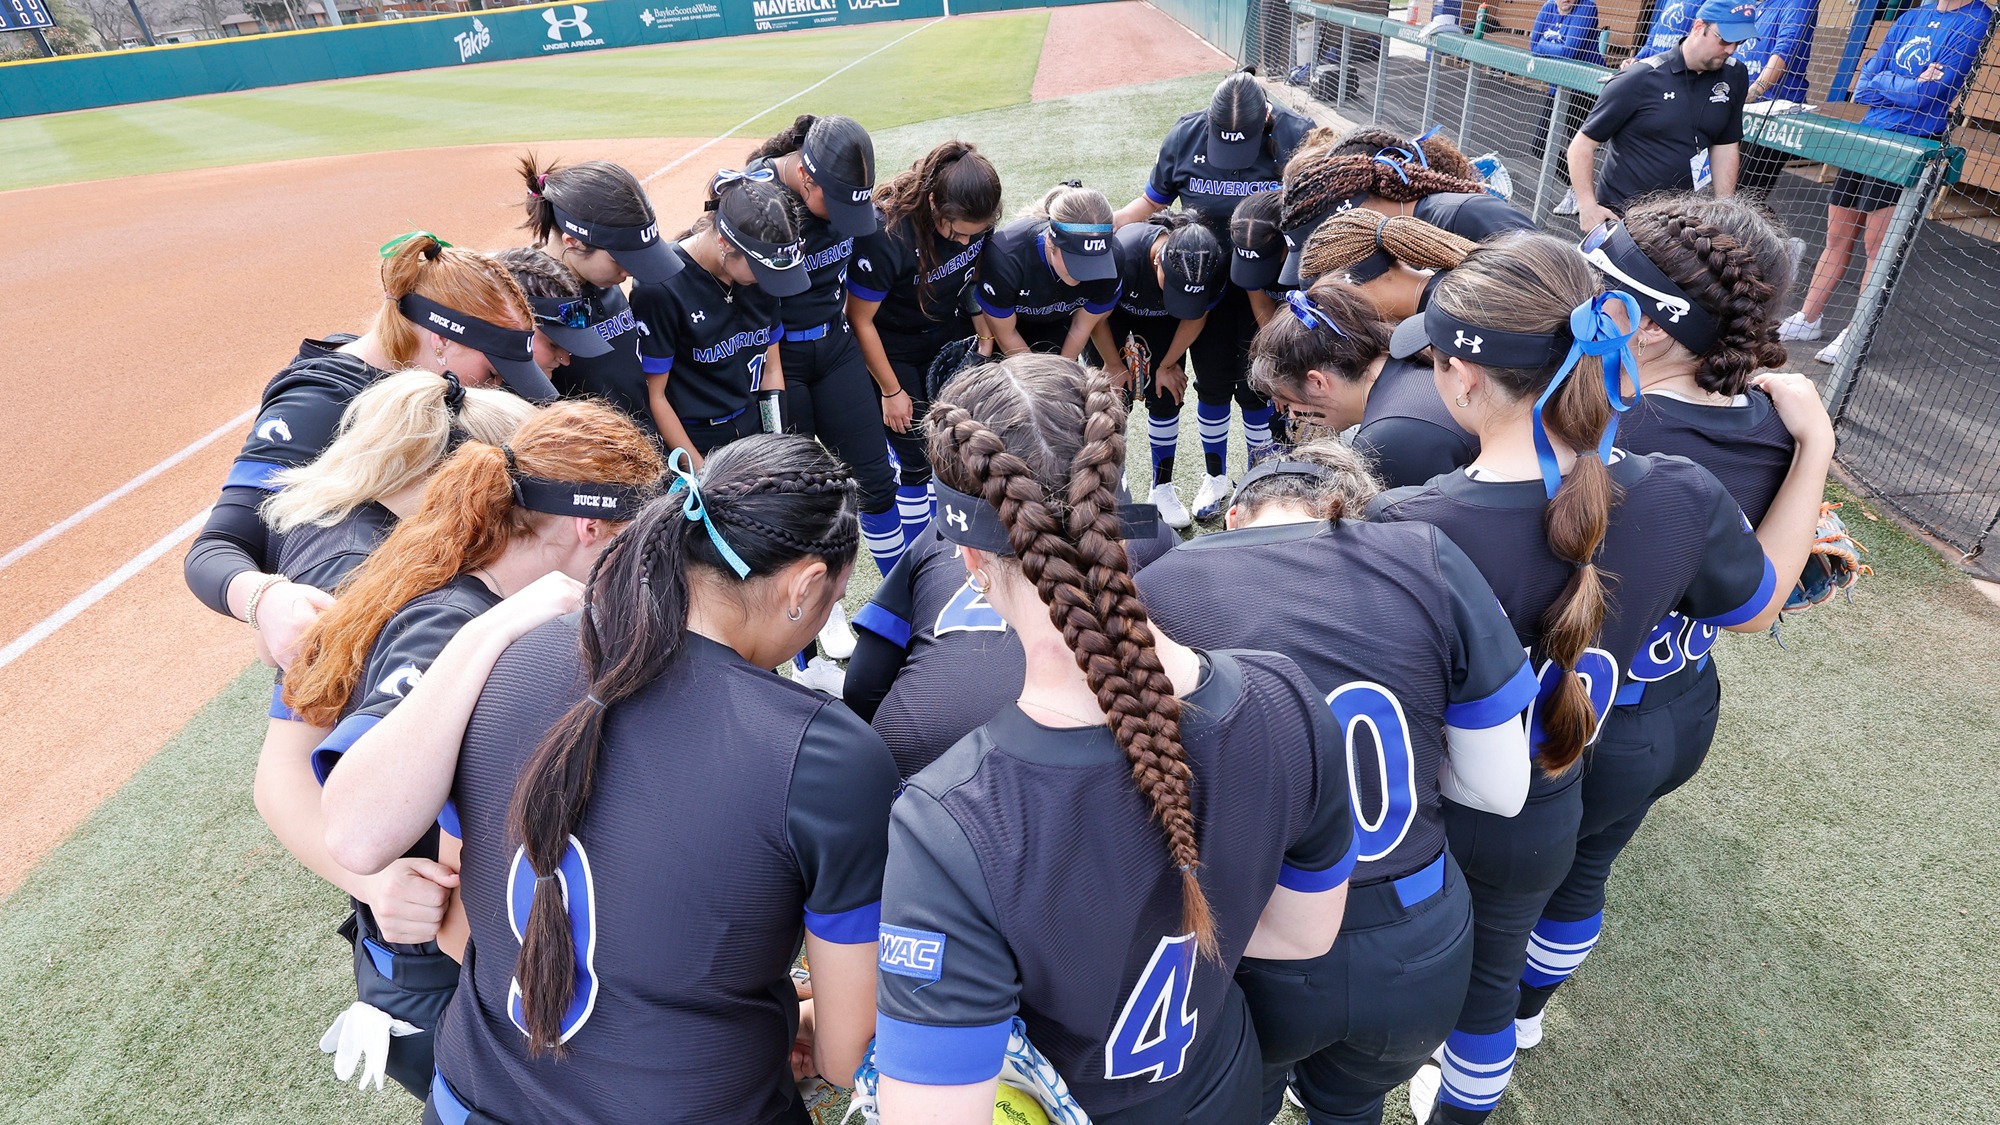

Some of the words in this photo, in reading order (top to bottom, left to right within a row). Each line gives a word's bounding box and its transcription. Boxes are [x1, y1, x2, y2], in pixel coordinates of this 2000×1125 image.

[756, 21, 773, 31] UTA
[454, 26, 491, 63] Takis
[543, 41, 570, 51] UNDER
[571, 38, 605, 48] ARMOUR
[1221, 131, 1245, 141] UTA
[1743, 114, 1803, 150] OFTBALL
[852, 188, 873, 201] UTA
[802, 236, 855, 272] AVERICK
[1084, 239, 1106, 251] UTA
[1237, 247, 1259, 259] UTA
[1184, 284, 1205, 294] UTA
[428, 311, 449, 331] BUCK
[449, 321, 465, 335] EM
[693, 324, 771, 363] MAVERICK
[747, 352, 768, 392] 1
[573, 494, 600, 507] BUCK
[602, 496, 617, 508] EM
[880, 932, 941, 971] WAC
[1105, 932, 1199, 1084] 4
